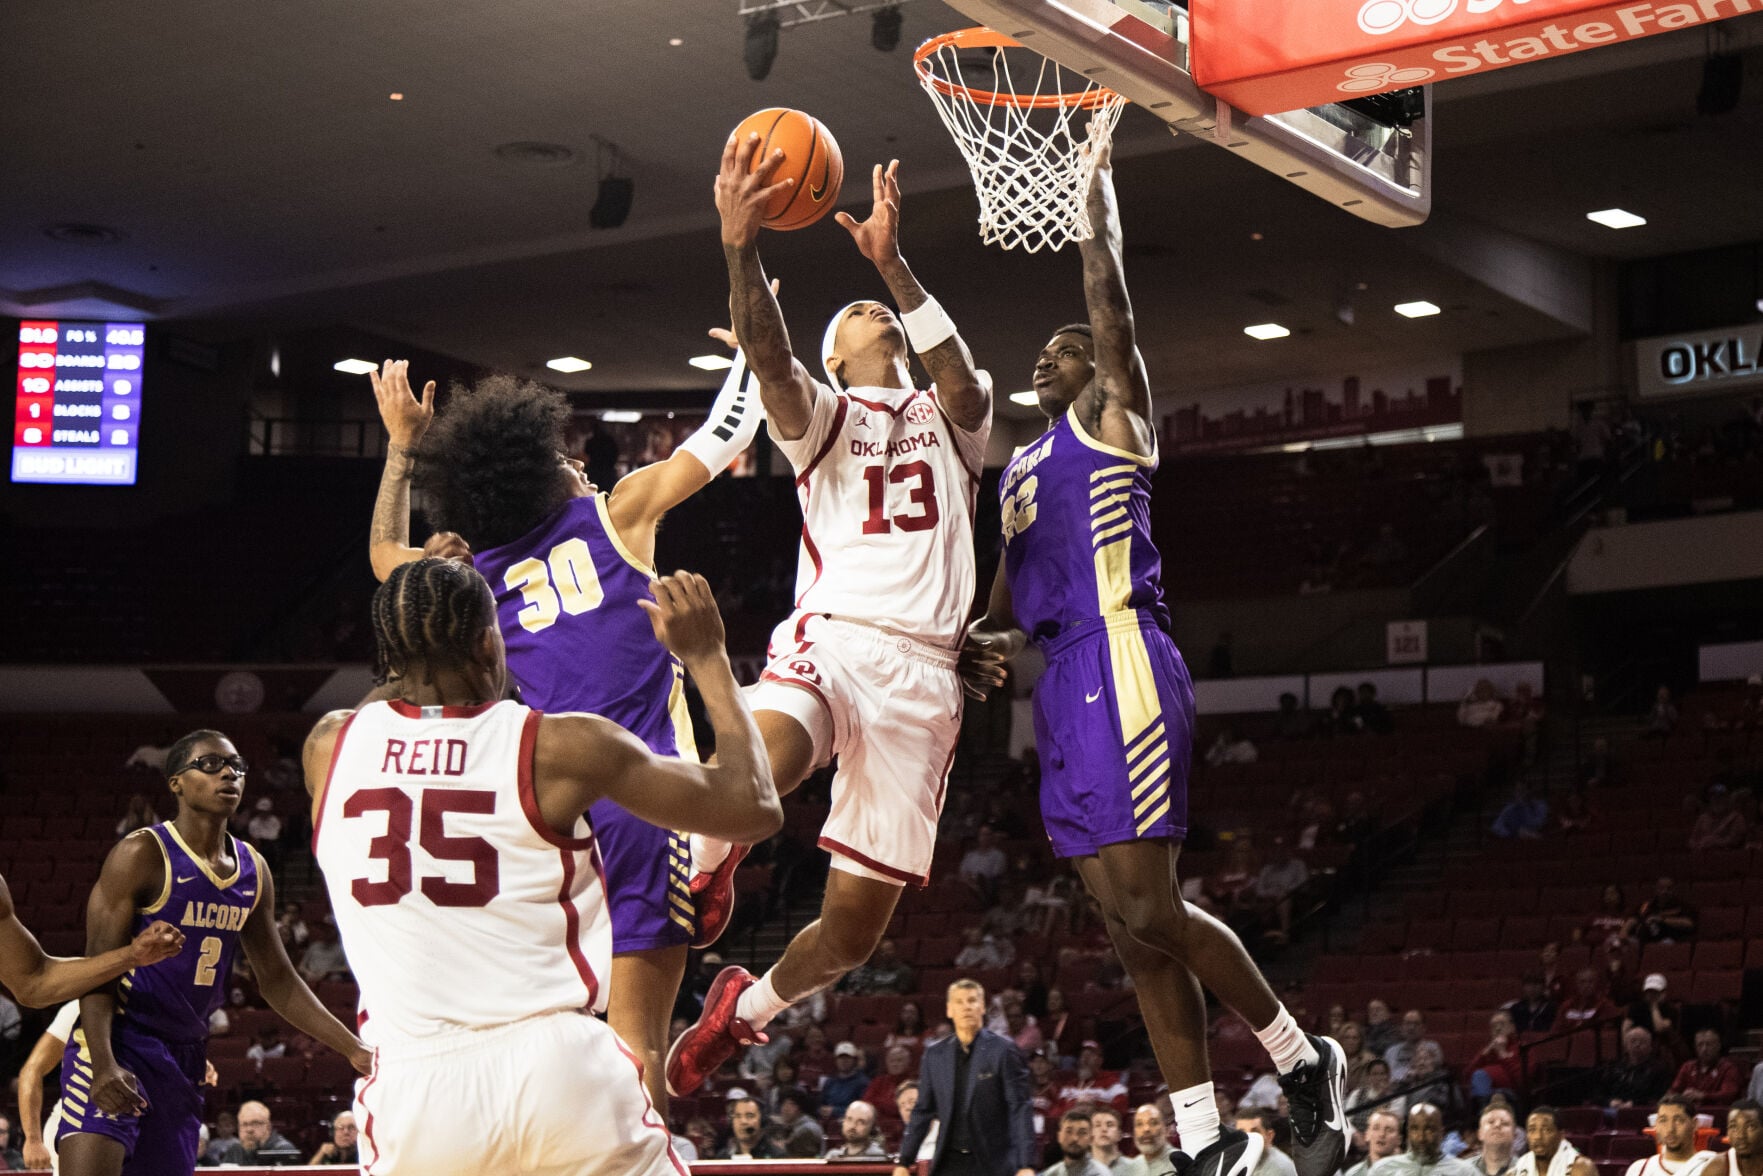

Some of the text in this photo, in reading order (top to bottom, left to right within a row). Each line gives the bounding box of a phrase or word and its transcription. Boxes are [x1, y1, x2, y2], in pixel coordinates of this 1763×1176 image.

[1432, 21, 1617, 73] State
[1661, 337, 1763, 382] OKL
[54, 379, 104, 392] ASSISTS
[29, 402, 40, 418] 1
[53, 404, 101, 417] BLOCKS
[907, 403, 935, 424] SEC
[53, 429, 100, 443] STEALS
[850, 431, 940, 457] OKLAHOMA
[20, 456, 125, 475] BUD LIGHT
[862, 460, 939, 535] 13
[503, 537, 605, 634] 30
[381, 738, 468, 776] REID
[343, 787, 500, 907] 35
[193, 936, 223, 986] 2
